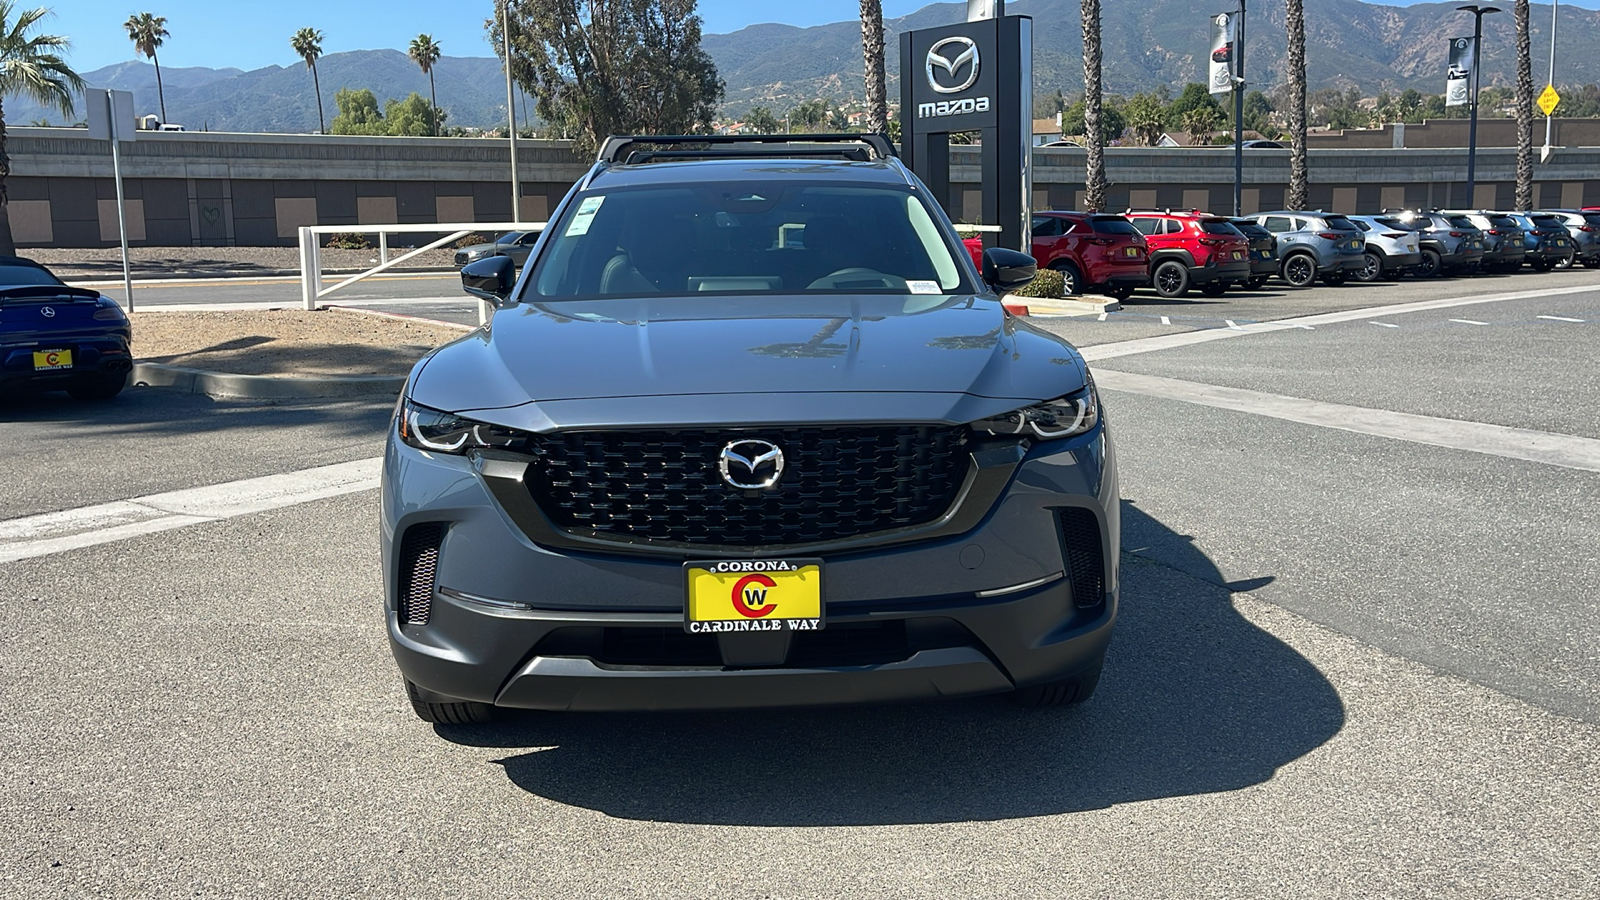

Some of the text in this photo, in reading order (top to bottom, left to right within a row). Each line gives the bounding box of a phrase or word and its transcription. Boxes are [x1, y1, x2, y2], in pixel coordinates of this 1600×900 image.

[717, 561, 790, 572] CORONA
[690, 619, 820, 633] CARDINALE WAY
